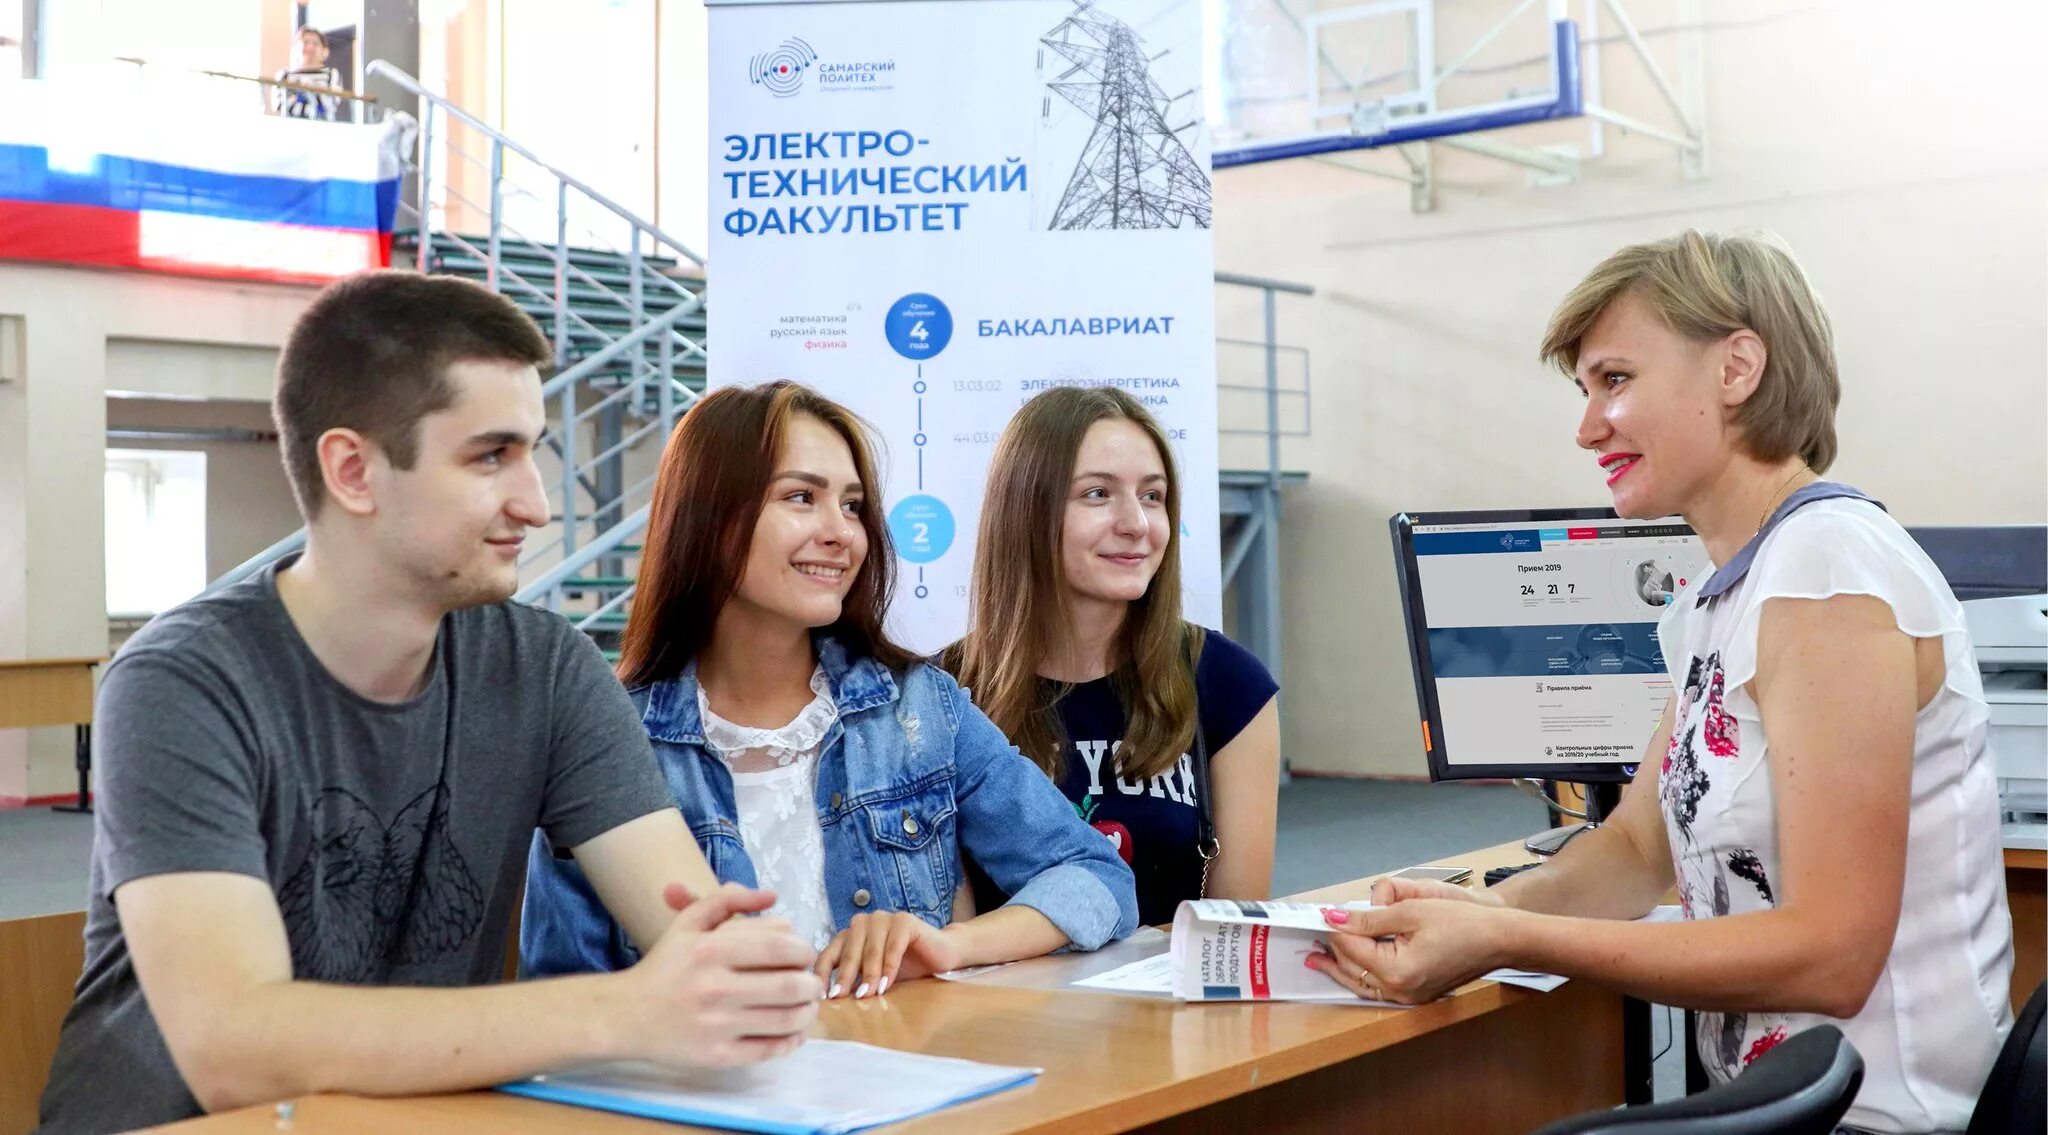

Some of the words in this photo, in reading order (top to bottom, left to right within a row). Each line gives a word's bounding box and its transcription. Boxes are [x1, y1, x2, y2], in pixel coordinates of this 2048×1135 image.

[819, 59, 895, 72] САМАРСКИЙ
[819, 73, 876, 83] ПОЛИТЕХ
[724, 129, 930, 162] ЭЛЕКТРО-
[723, 156, 1027, 199] ТЕХНИЧЕСКИЙ
[723, 202, 970, 237] ФАКУЛЬТЕТ
[780, 315, 847, 324] математика
[770, 327, 817, 338] русский
[819, 328, 847, 336] язык
[910, 320, 929, 341] 4
[978, 316, 1174, 337] БАКАЛАВРИАТ
[804, 340, 847, 350] физика
[953, 380, 1002, 392] 13.03.02
[911, 521, 930, 543] 2
[1518, 565, 1544, 573] Прием
[1520, 585, 1535, 595] 24
[1547, 584, 1558, 594] 21
[1567, 584, 1575, 594] 7
[1585, 751, 1609, 759] учебный
[1202, 936, 1211, 983] КАТАЛОГ
[1230, 923, 1242, 983] ПРОДУКТОВ
